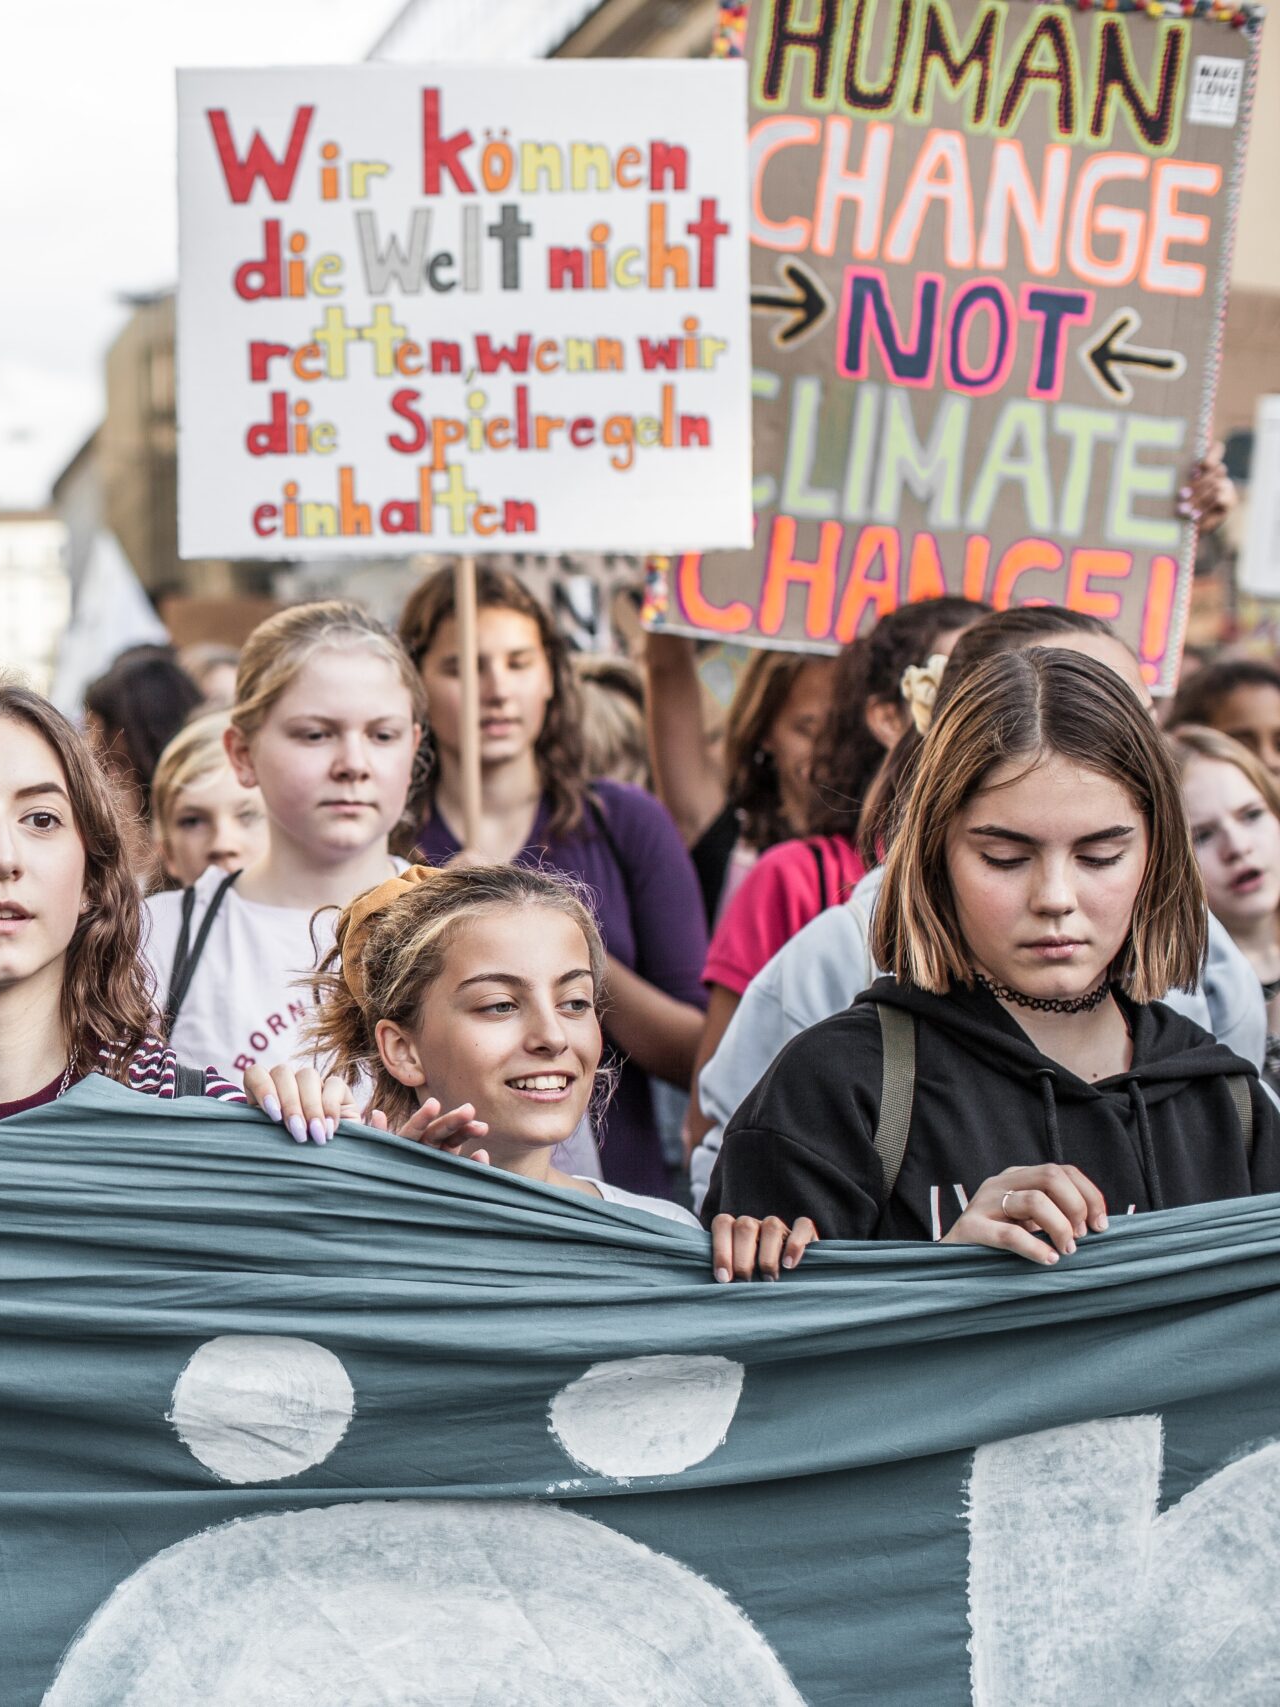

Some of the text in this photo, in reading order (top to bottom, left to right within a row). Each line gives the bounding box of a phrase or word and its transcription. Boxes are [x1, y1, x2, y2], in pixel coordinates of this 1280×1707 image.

[757, 0, 1190, 152] HUMAN
[205, 86, 689, 205] Wir können
[233, 197, 730, 300] die Welt nicht
[747, 115, 1222, 296] CHANGE
[638, 316, 726, 371] wir
[836, 266, 1094, 400] NOT
[245, 382, 711, 472] die Spielregeln
[251, 463, 538, 537] einhalten
